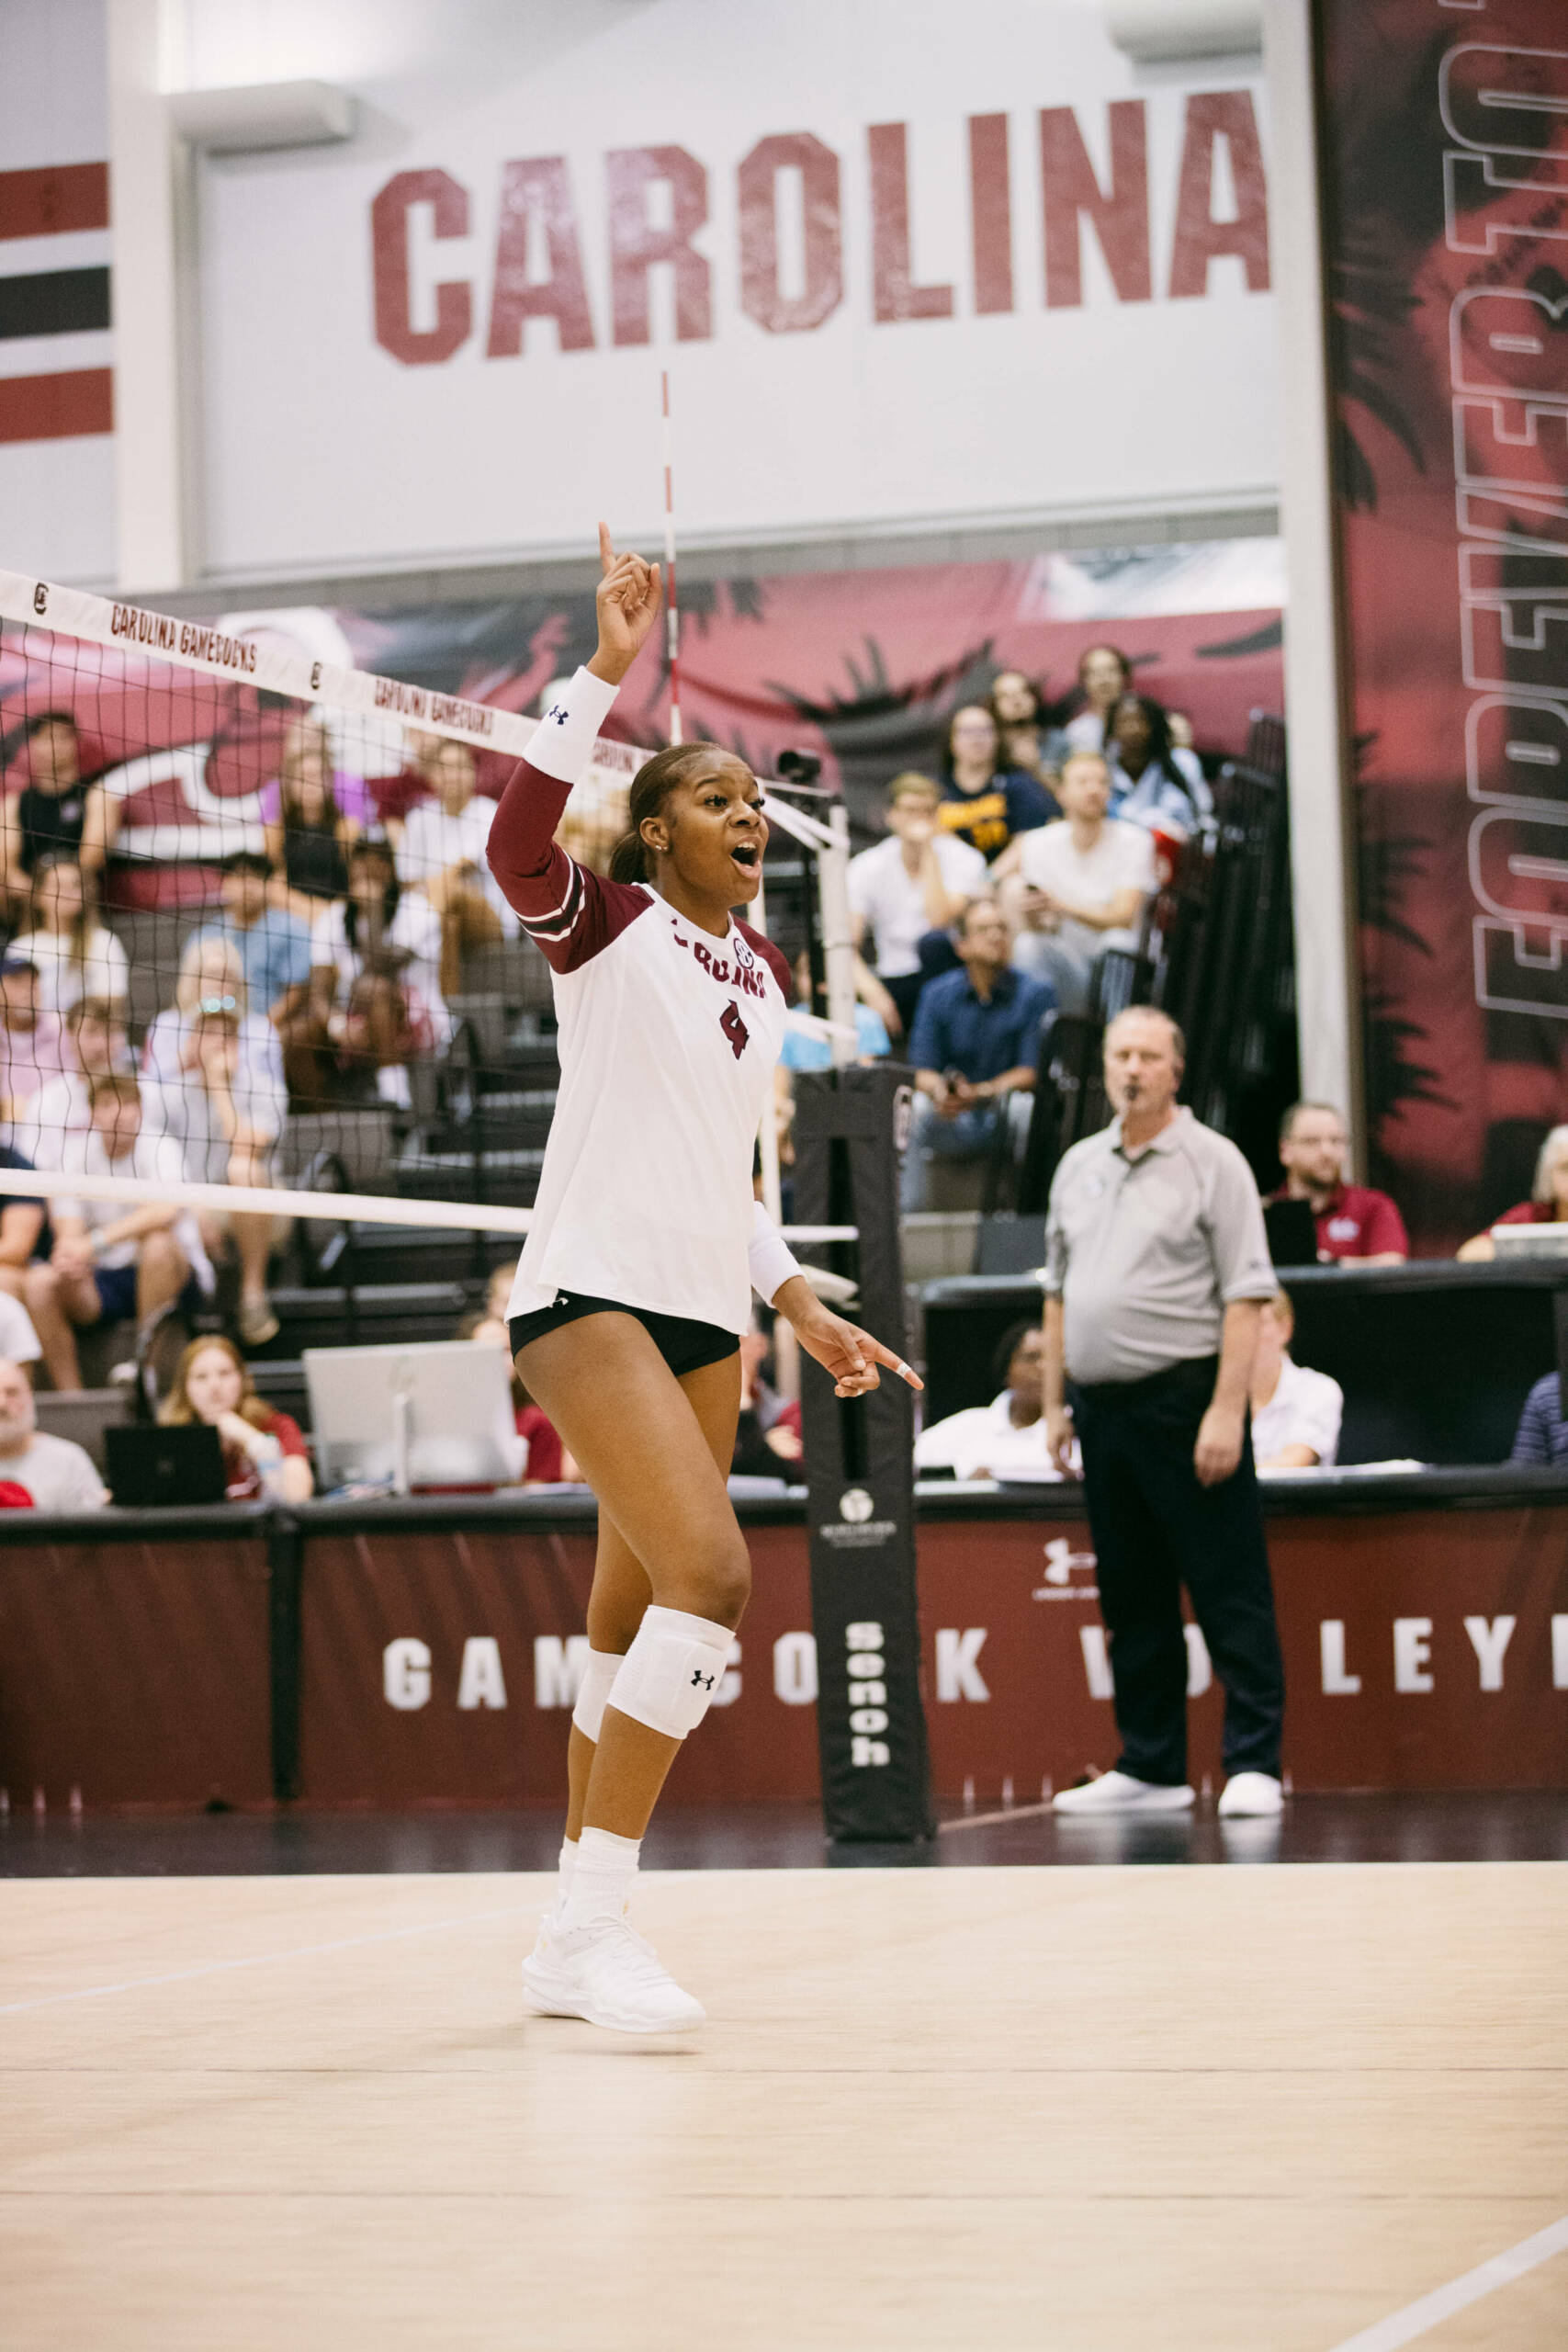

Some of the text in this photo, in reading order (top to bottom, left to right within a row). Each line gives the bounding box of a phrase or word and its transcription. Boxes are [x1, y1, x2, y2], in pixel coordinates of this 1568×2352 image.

[371, 89, 1274, 366] CAROLINA
[111, 604, 176, 650] CAROLINA
[671, 918, 766, 999] ROINA
[719, 999, 750, 1060] 4
[382, 1628, 991, 1711] GAMOK
